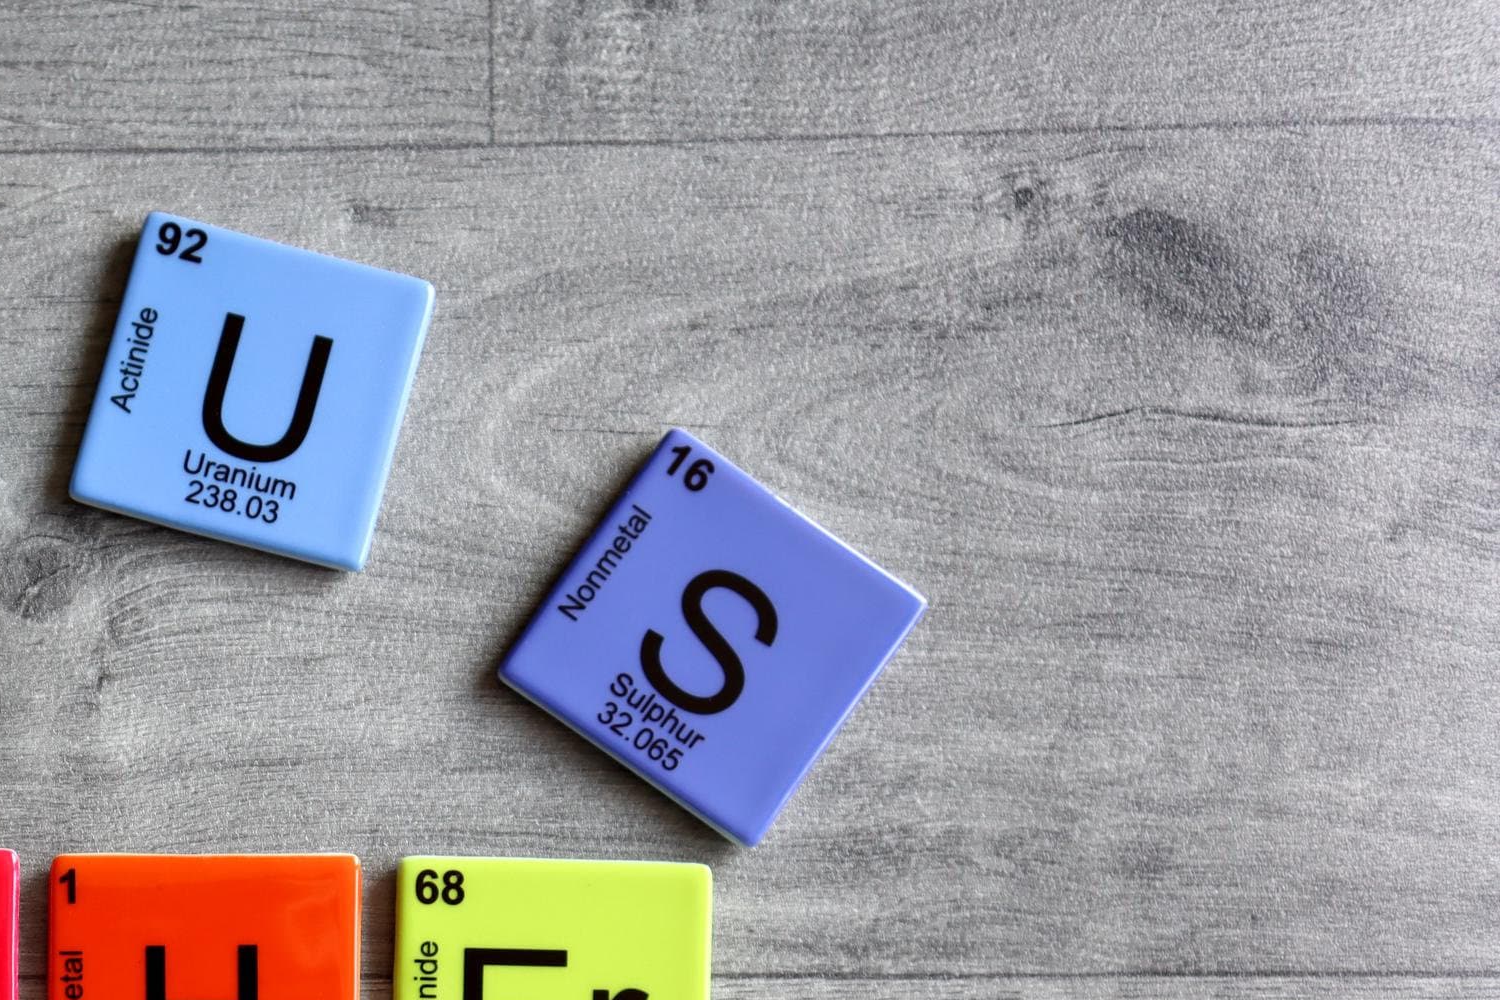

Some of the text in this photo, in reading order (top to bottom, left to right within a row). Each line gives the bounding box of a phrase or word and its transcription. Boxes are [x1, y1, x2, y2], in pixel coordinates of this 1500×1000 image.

[155, 221, 209, 265] 92
[110, 307, 159, 414] Actinide
[201, 311, 334, 464] U
[183, 449, 297, 500] Uranium
[666, 445, 715, 493] 16
[184, 479, 280, 524] 238.03
[557, 504, 652, 622] Nonmetal
[639, 569, 779, 716] S
[597, 701, 684, 771] 32.065
[610, 672, 705, 749] Sulphur
[58, 868, 77, 905] 1
[414, 868, 465, 906] 68
